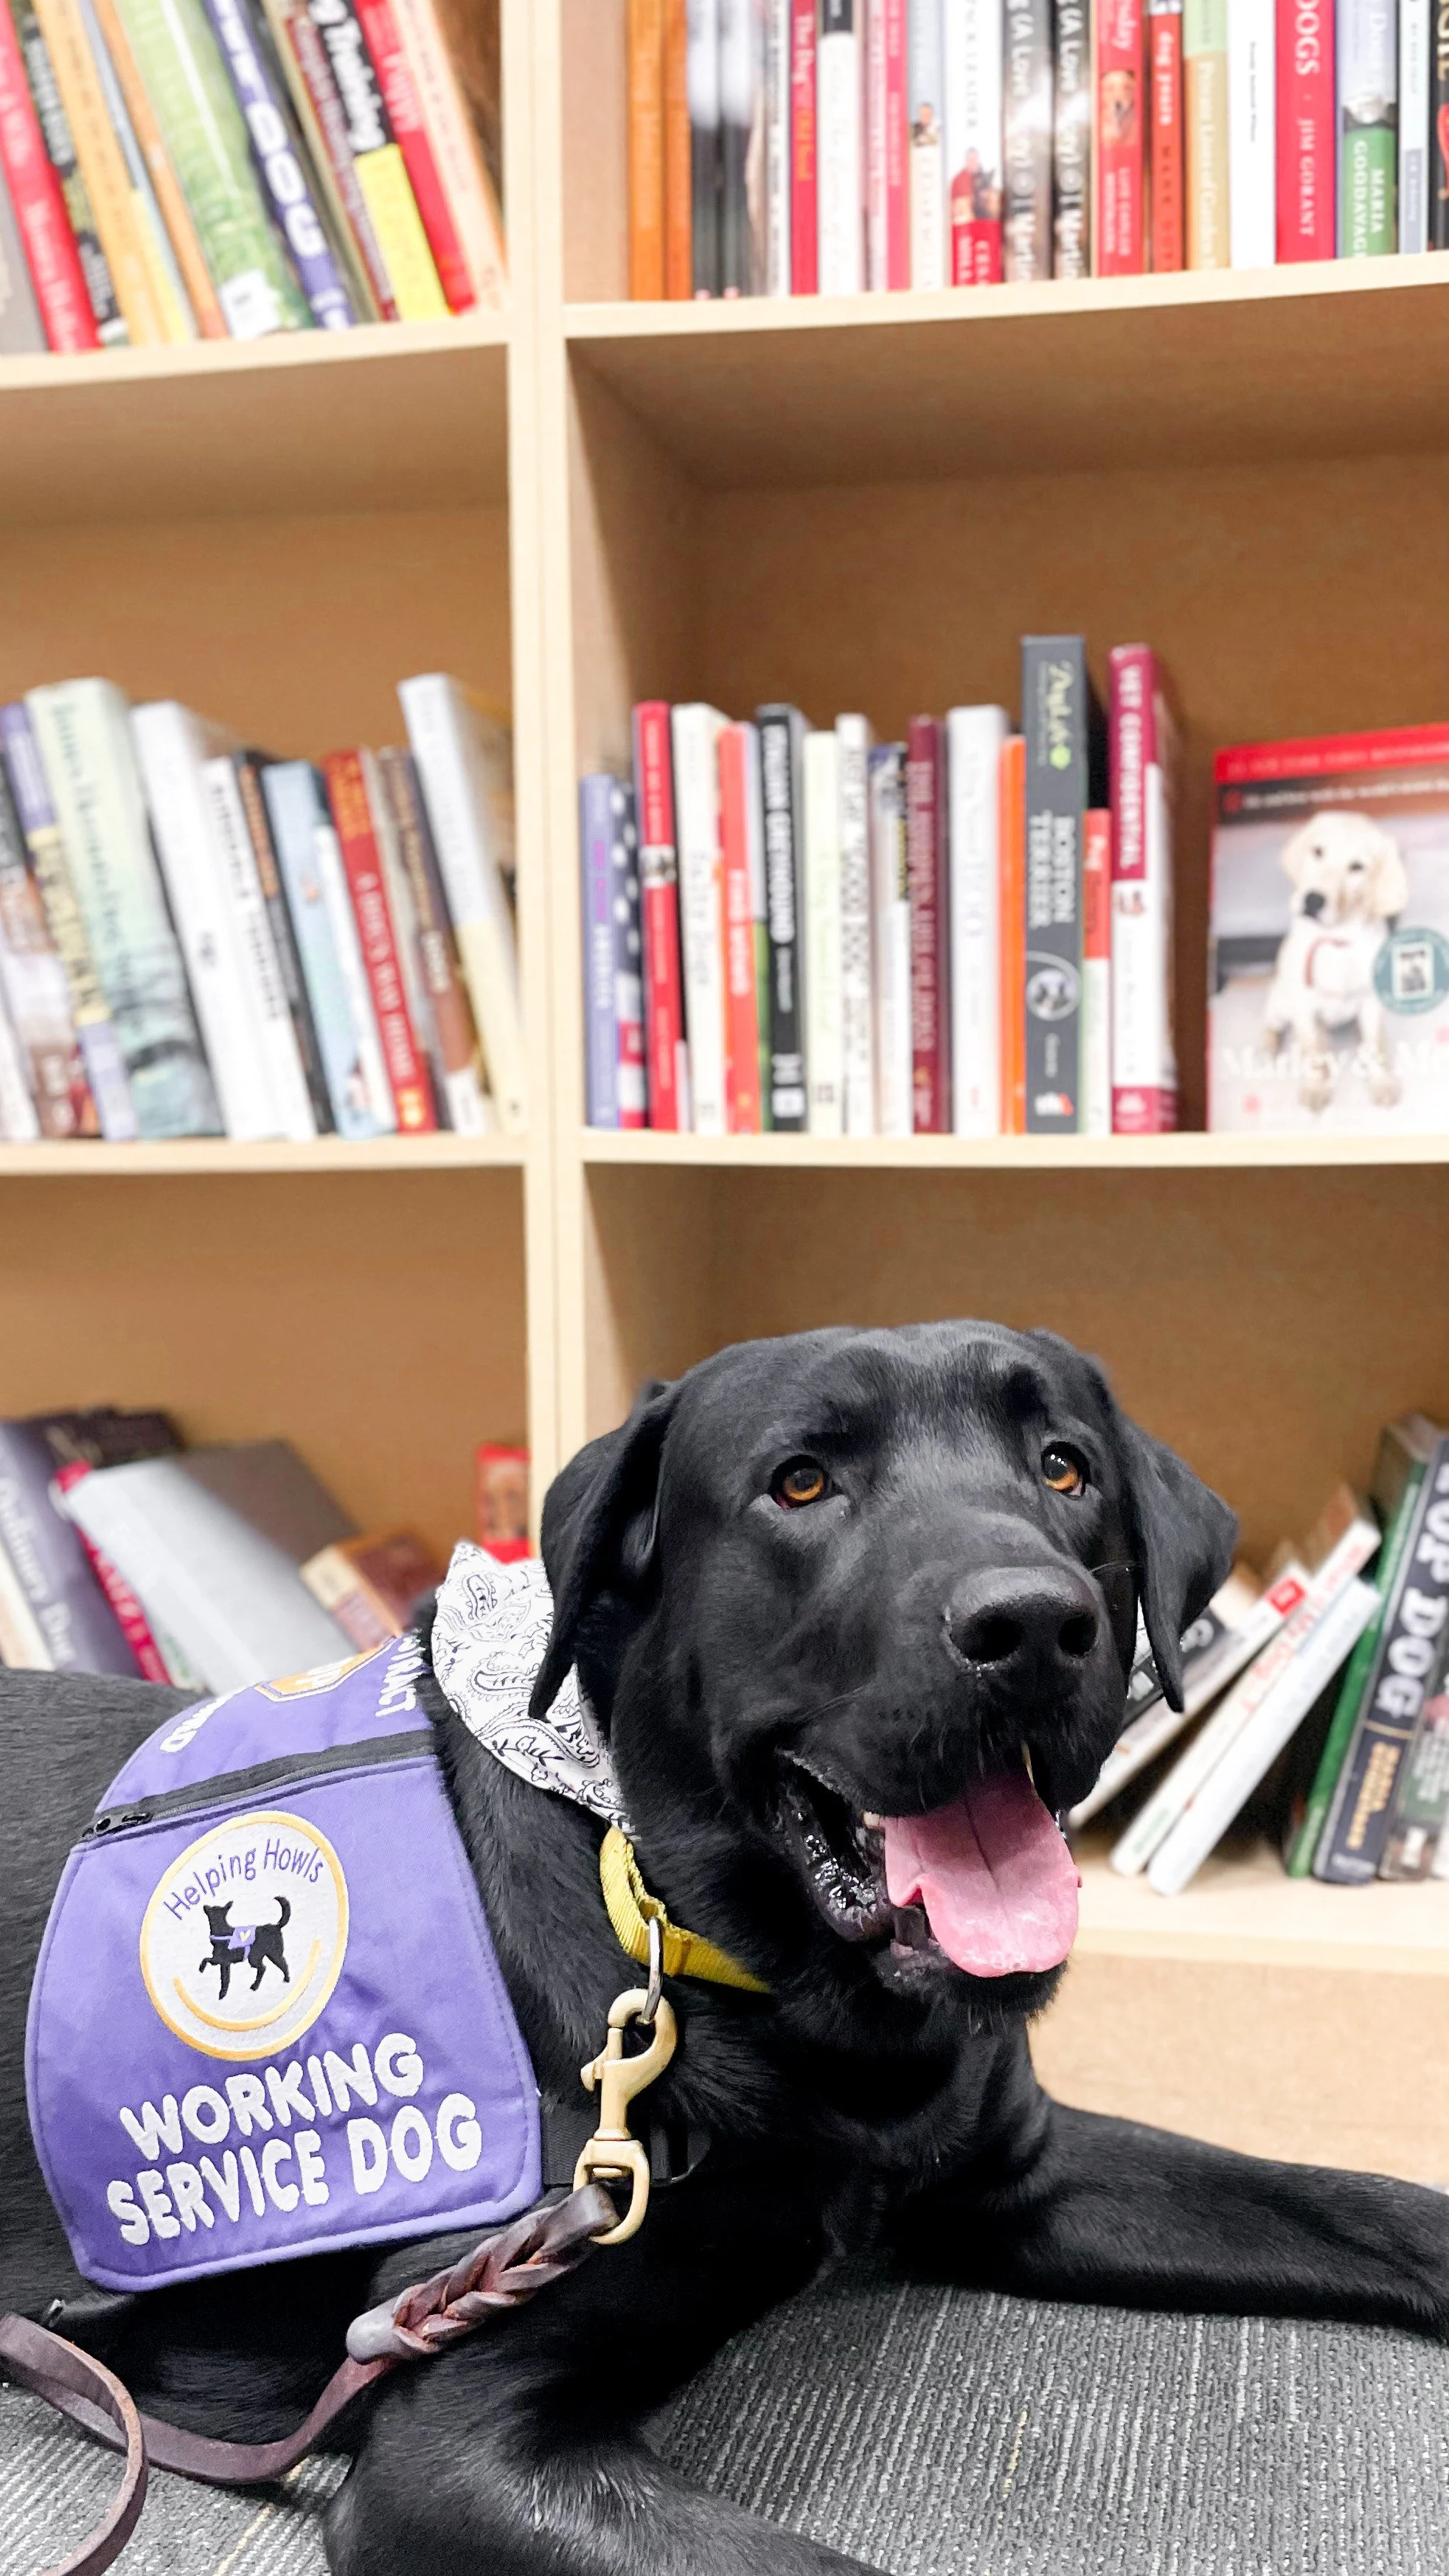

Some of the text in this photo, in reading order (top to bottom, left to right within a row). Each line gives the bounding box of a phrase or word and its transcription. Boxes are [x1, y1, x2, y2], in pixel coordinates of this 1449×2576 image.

[246, 101, 326, 257] DOG
[1296, 118, 1317, 237] JIM GORANT
[1369, 168, 1386, 235] MARIA
[1119, 665, 1143, 869] VET CONFIDENTIAL
[765, 812, 796, 943] GREYHOUND
[1029, 809, 1054, 930] TERRIER
[1053, 816, 1077, 923] BOSTON
[1375, 1586, 1447, 1719] DOG
[163, 1839, 324, 1921] Helping Howls
[119, 2032, 423, 2161] WORKING
[107, 2093, 482, 2246] SERVICE DOG
